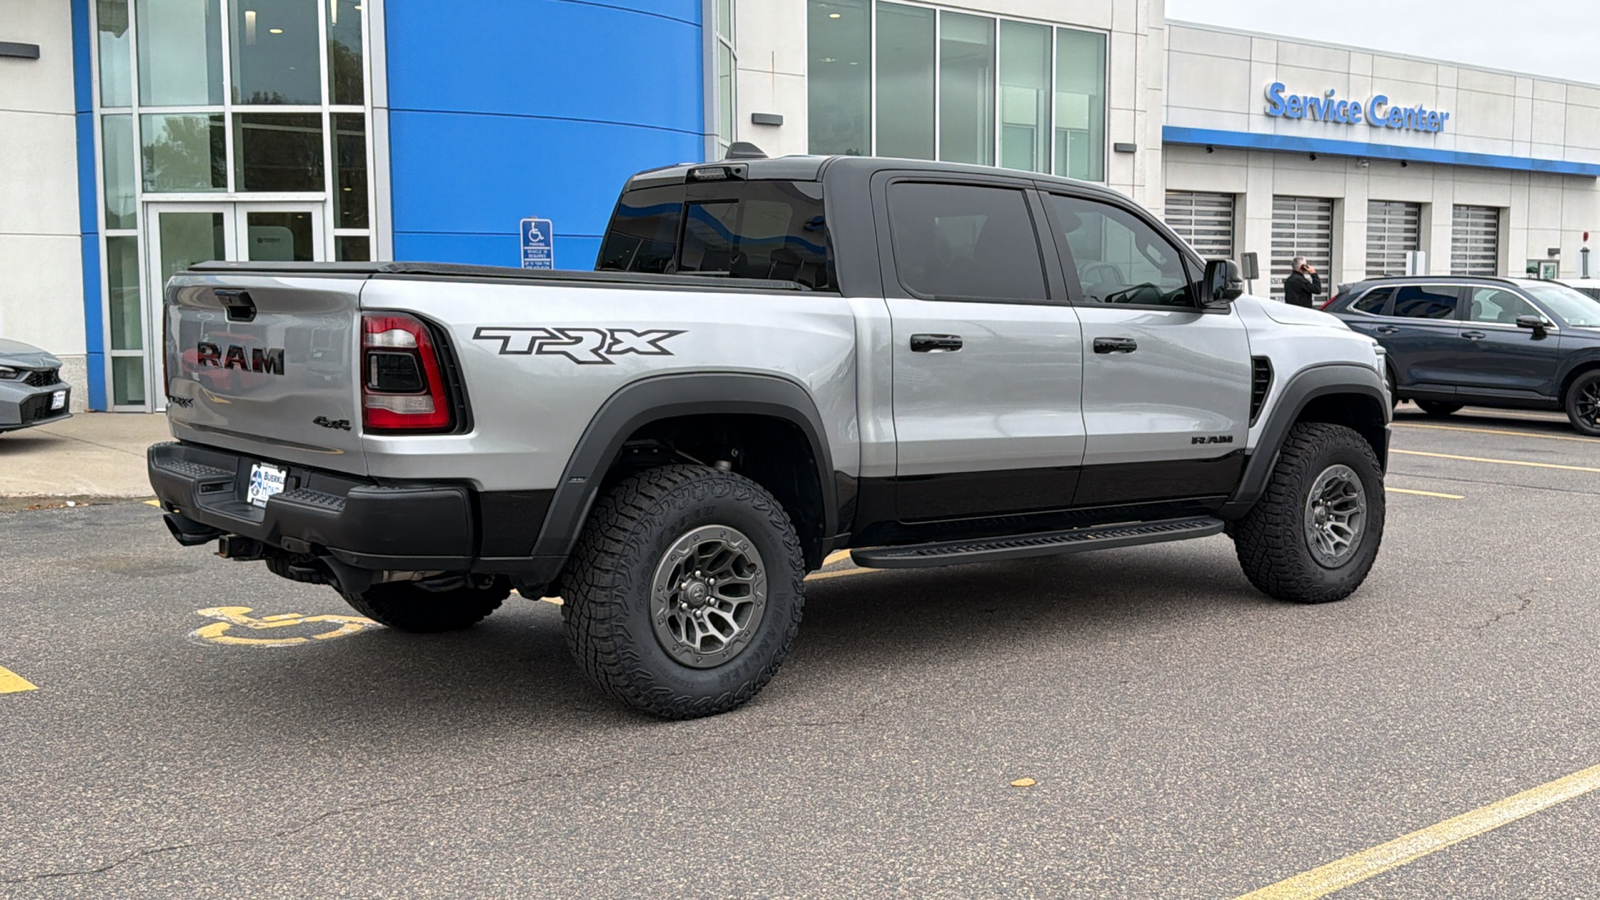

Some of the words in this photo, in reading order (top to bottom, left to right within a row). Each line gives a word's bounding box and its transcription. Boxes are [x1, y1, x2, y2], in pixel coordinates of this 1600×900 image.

[1264, 82, 1362, 124] Service
[1365, 94, 1450, 132] Center
[197, 341, 285, 375] RAM
[472, 327, 689, 365] TRX
[1191, 435, 1233, 445] RAM
